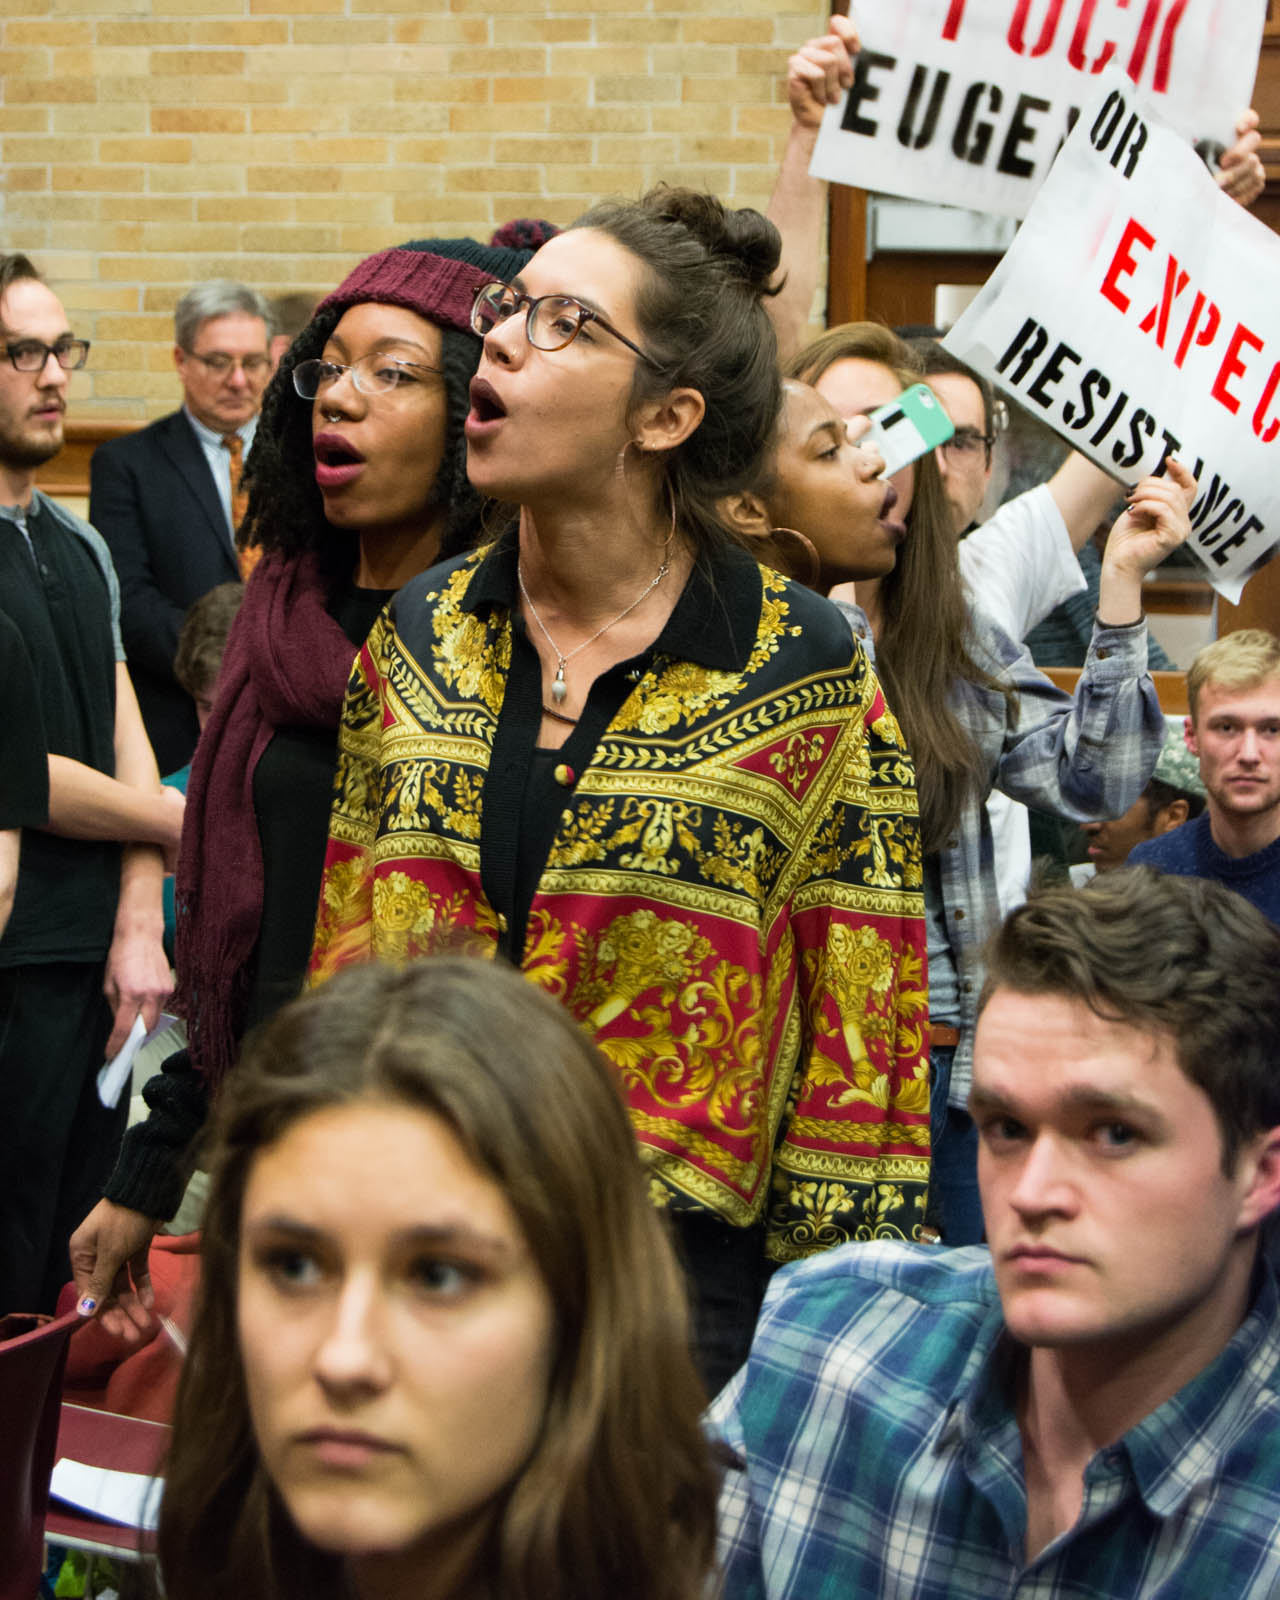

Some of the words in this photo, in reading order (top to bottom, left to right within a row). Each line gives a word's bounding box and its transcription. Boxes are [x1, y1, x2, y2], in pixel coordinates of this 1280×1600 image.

[840, 48, 1081, 178] EUGE
[1090, 89, 1148, 179] OR
[995, 317, 1264, 566] RESISTNCE
